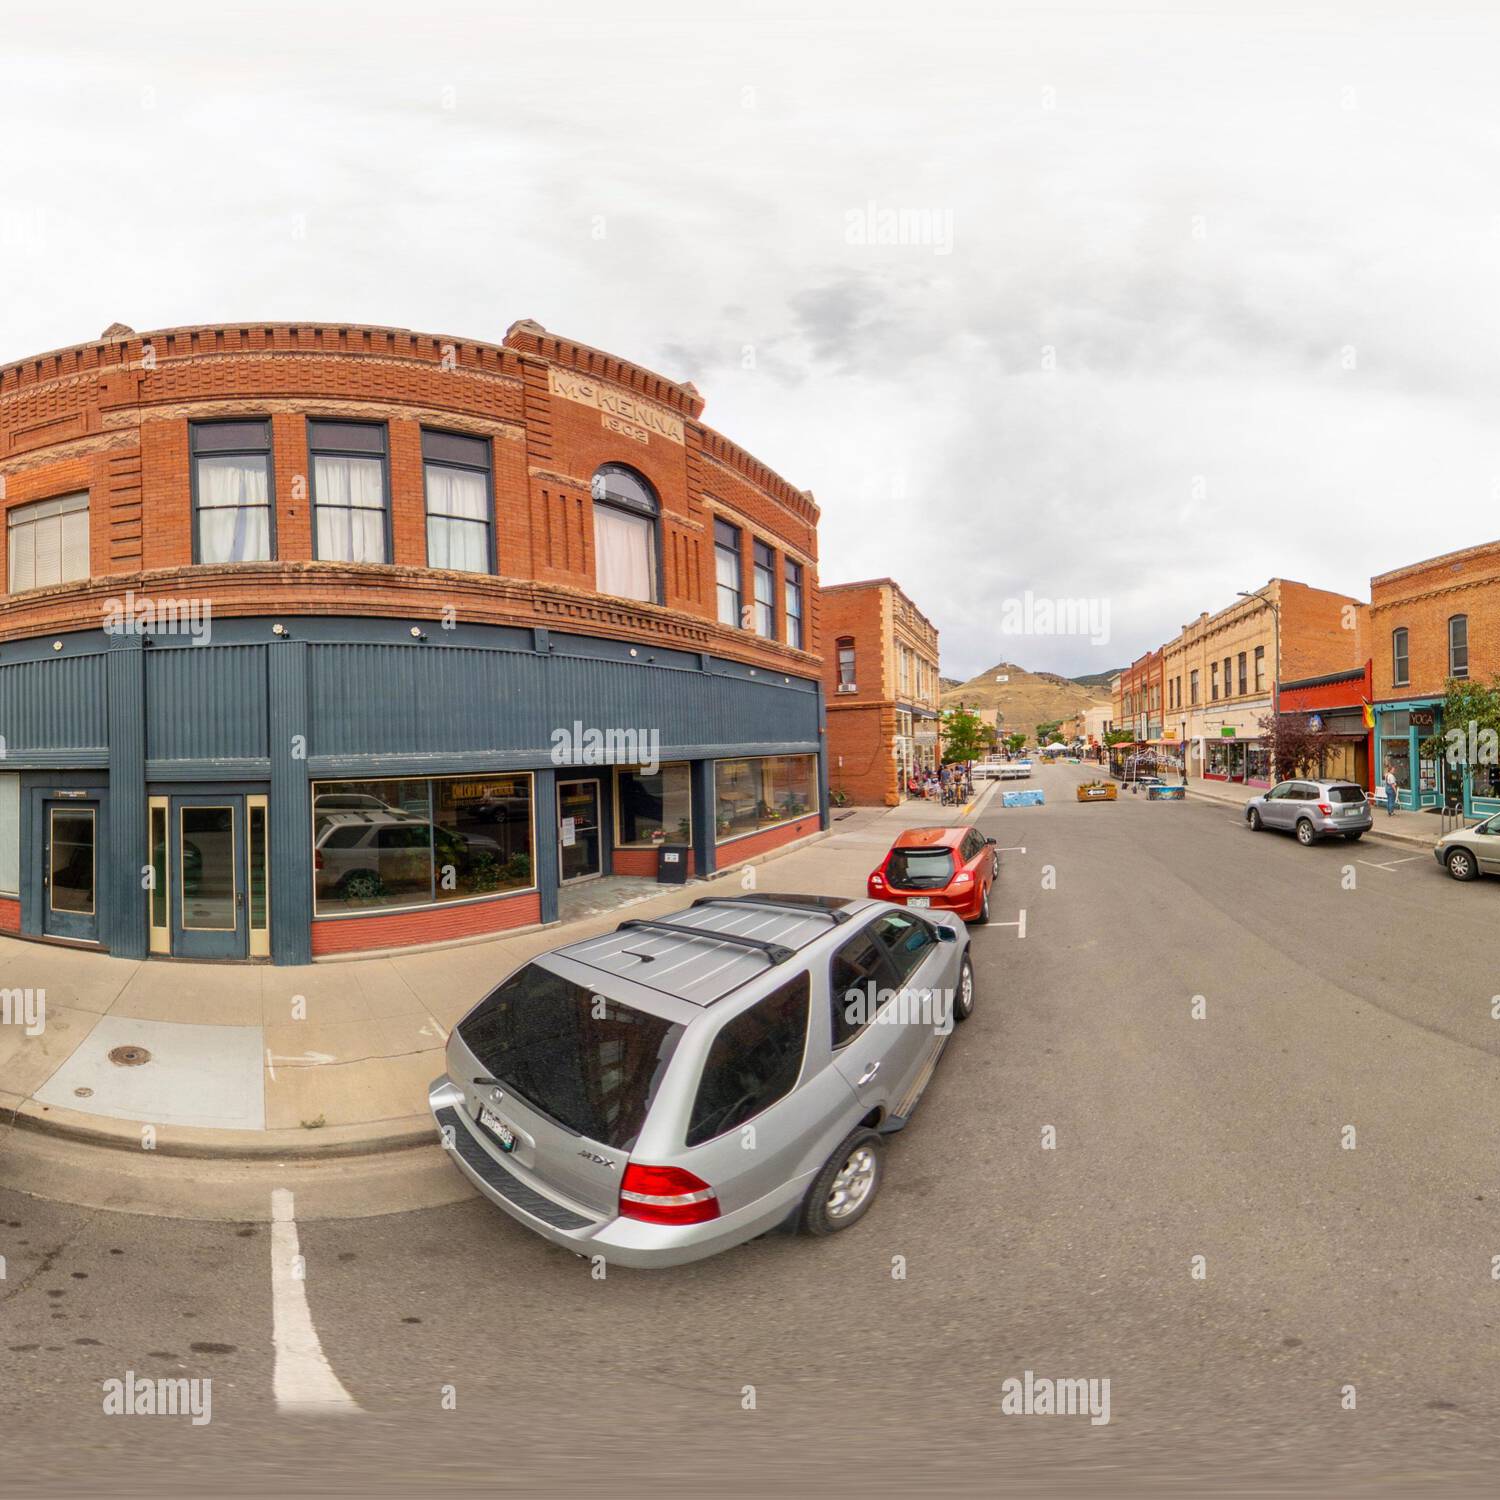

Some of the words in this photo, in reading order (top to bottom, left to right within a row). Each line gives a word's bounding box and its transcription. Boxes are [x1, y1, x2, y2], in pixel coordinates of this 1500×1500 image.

[603, 415, 648, 443] 1902
[1410, 713, 1433, 726] YOGA
[577, 1150, 616, 1170] MDX
